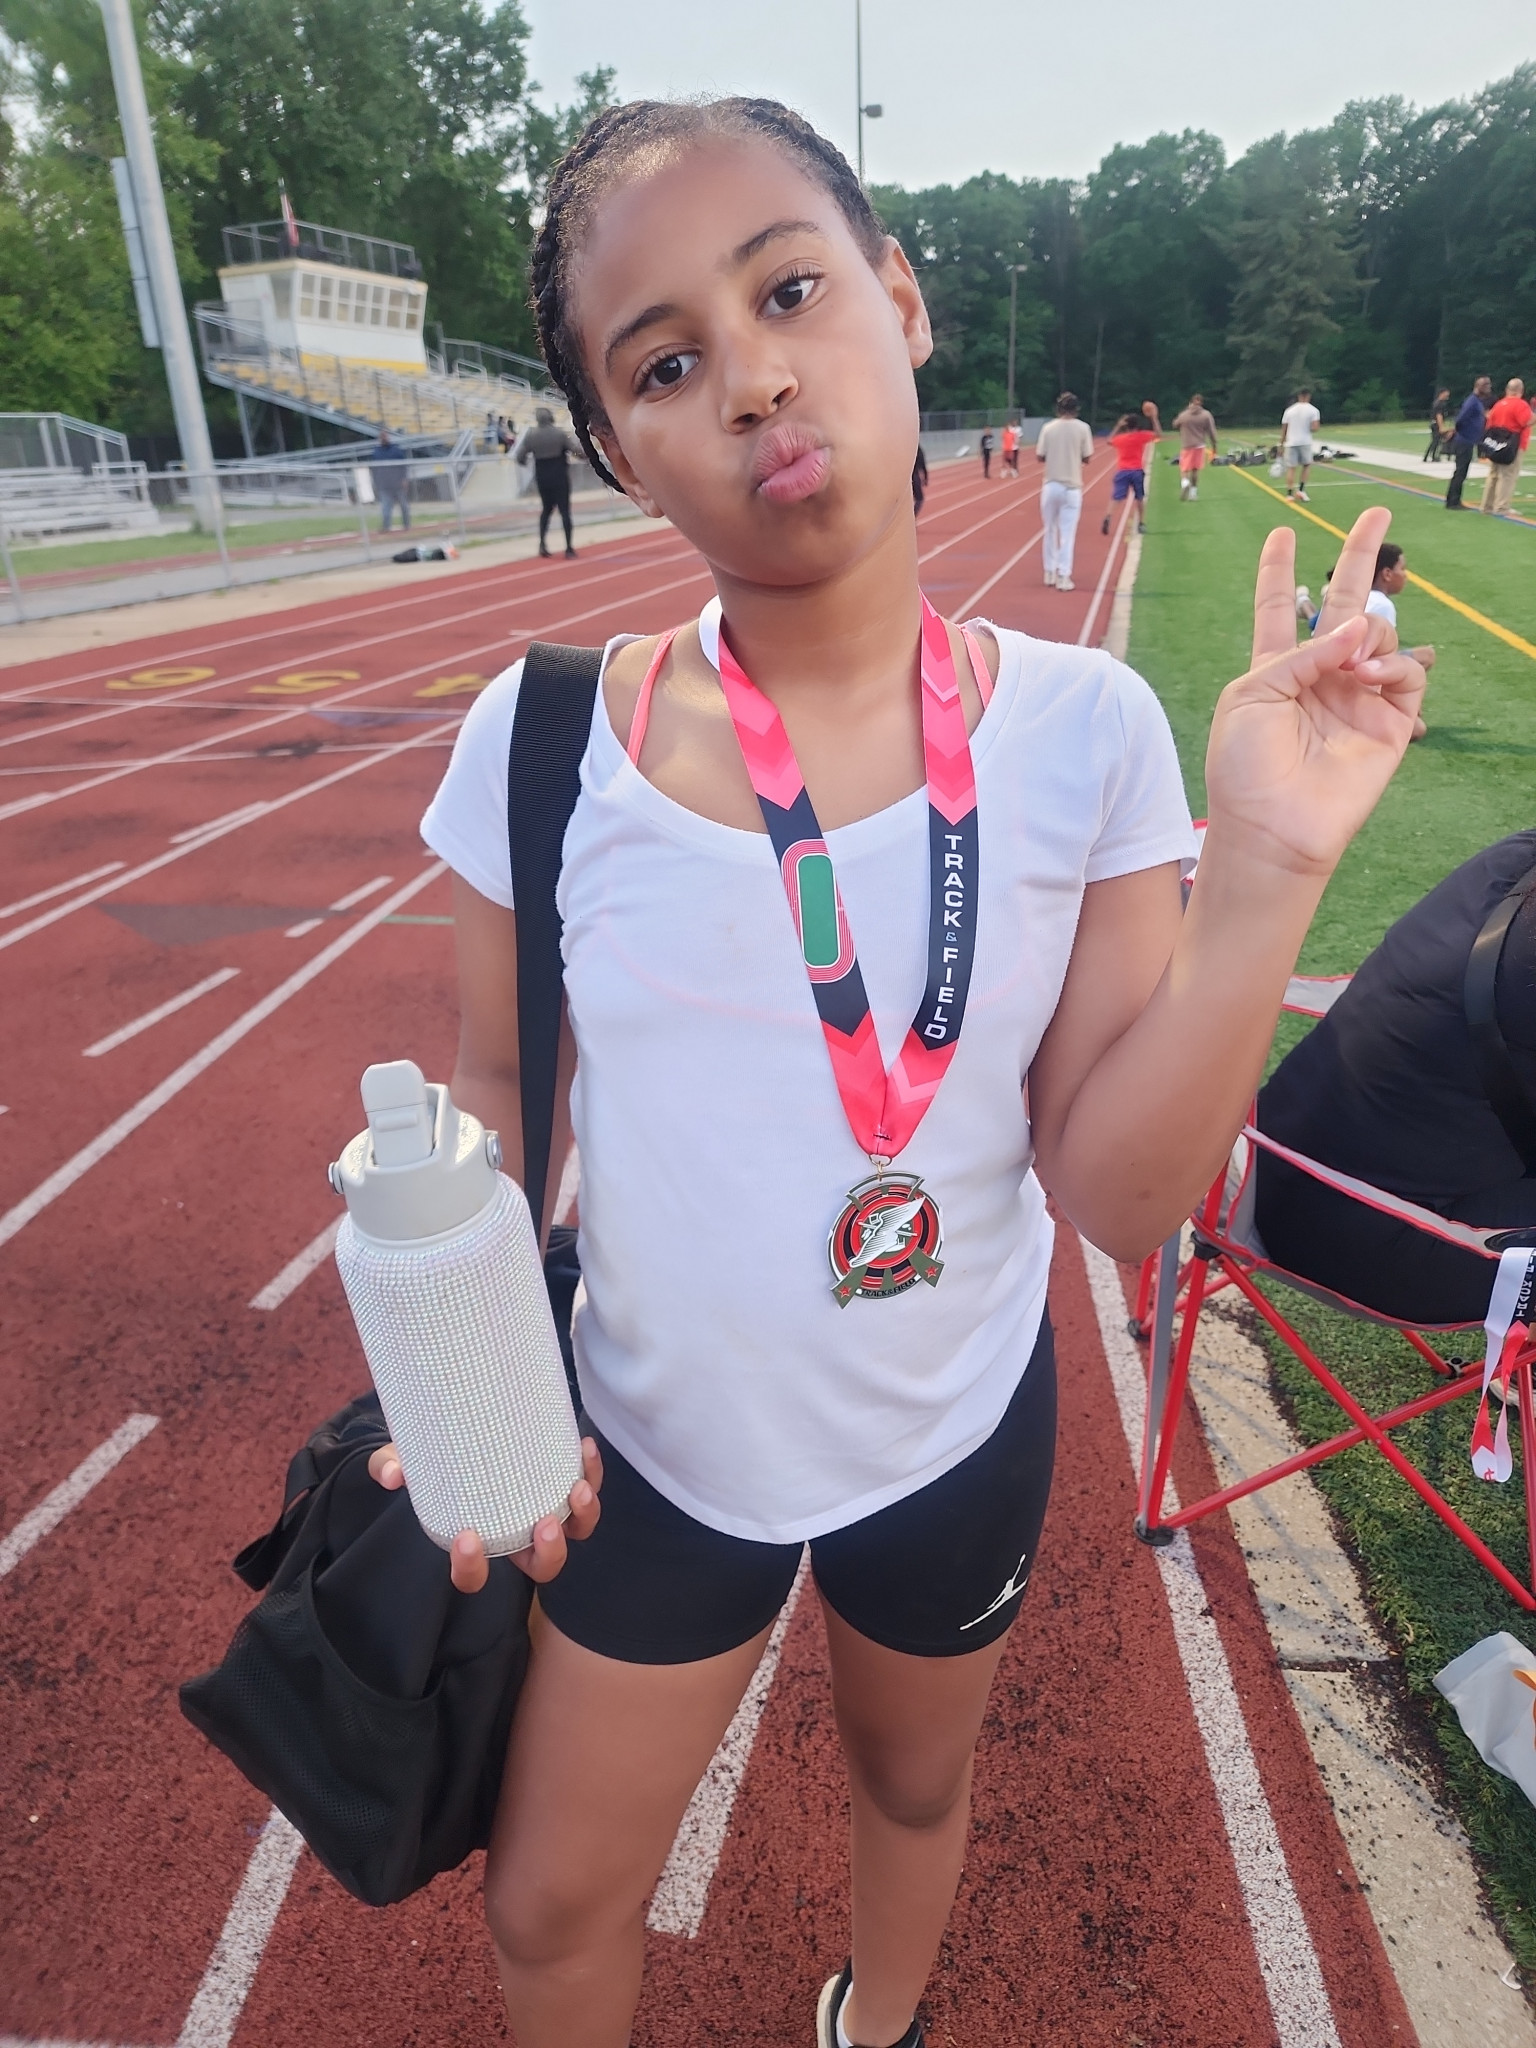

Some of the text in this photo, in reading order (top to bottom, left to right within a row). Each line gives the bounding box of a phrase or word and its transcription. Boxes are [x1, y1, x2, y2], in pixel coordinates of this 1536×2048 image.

[923, 834, 964, 1040] TRACK & FIELD
